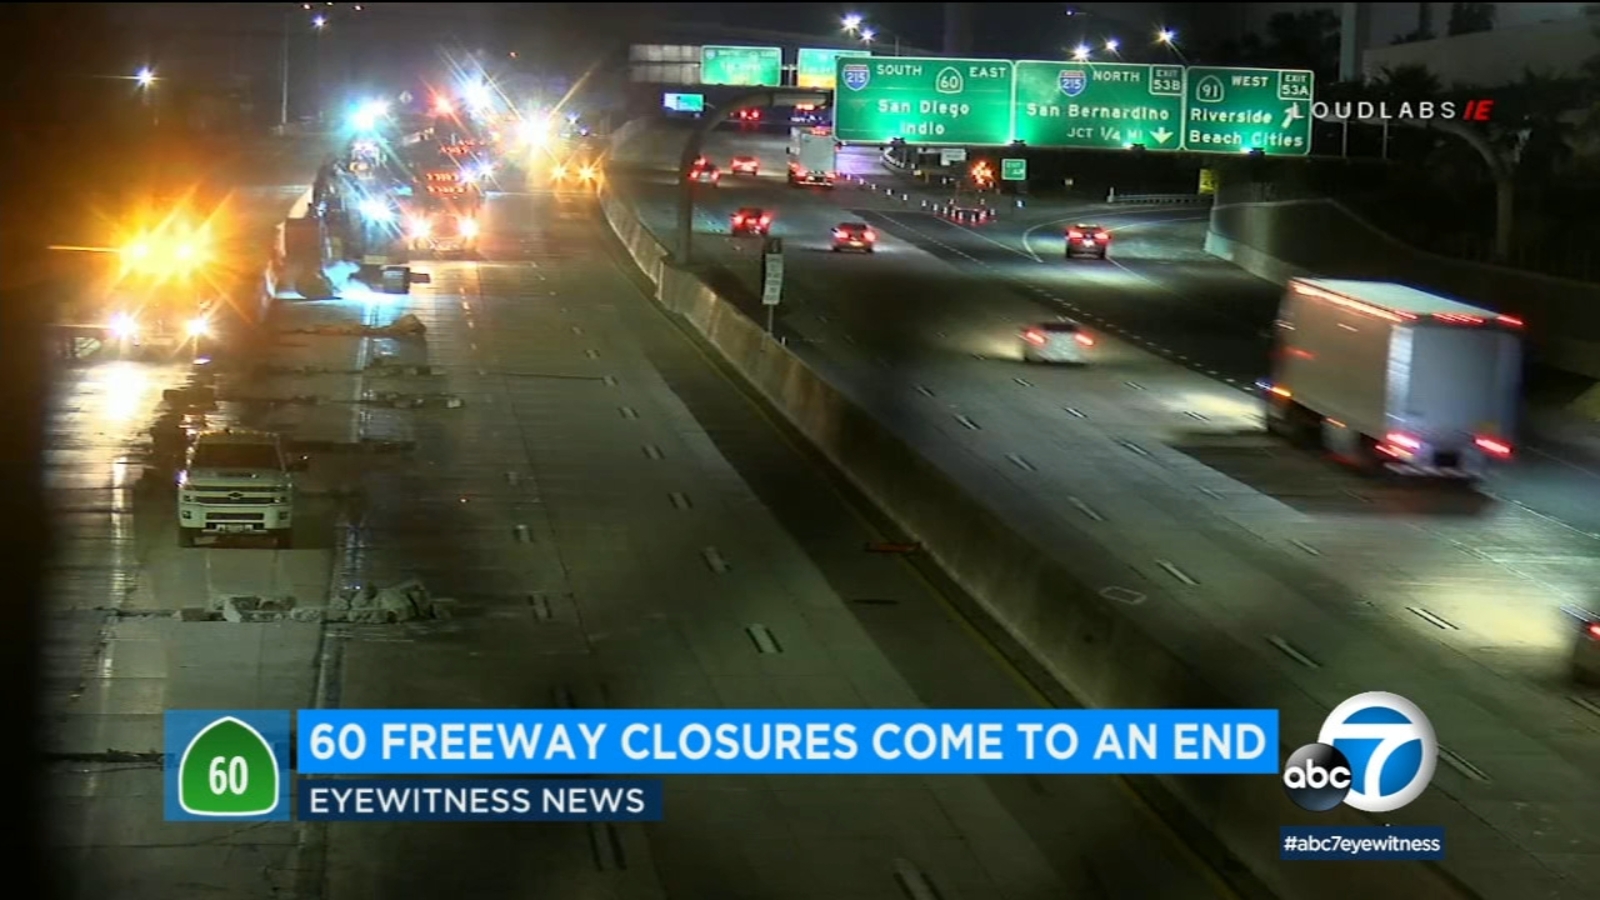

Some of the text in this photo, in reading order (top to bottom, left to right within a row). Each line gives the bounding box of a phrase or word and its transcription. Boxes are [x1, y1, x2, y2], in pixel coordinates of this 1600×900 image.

[876, 64, 921, 76] SOUTH
[969, 66, 1006, 78] EAST
[1092, 70, 1140, 82] NORTH
[1155, 69, 1178, 78] EXIT
[846, 72, 866, 83] 215
[939, 75, 957, 89] 60
[1231, 75, 1269, 87] WEST
[1284, 74, 1306, 83] EXIT
[1062, 79, 1082, 90] 215
[1153, 79, 1181, 91] 53B
[1202, 84, 1218, 97] 91
[1281, 84, 1309, 96] 53A
[877, 99, 970, 118] San Diego
[1026, 103, 1170, 121] San Bernardino
[1190, 108, 1272, 124] Riverside
[901, 123, 945, 136] Indio
[1067, 127, 1093, 139] JCT
[1190, 131, 1303, 147] Beach Cities
